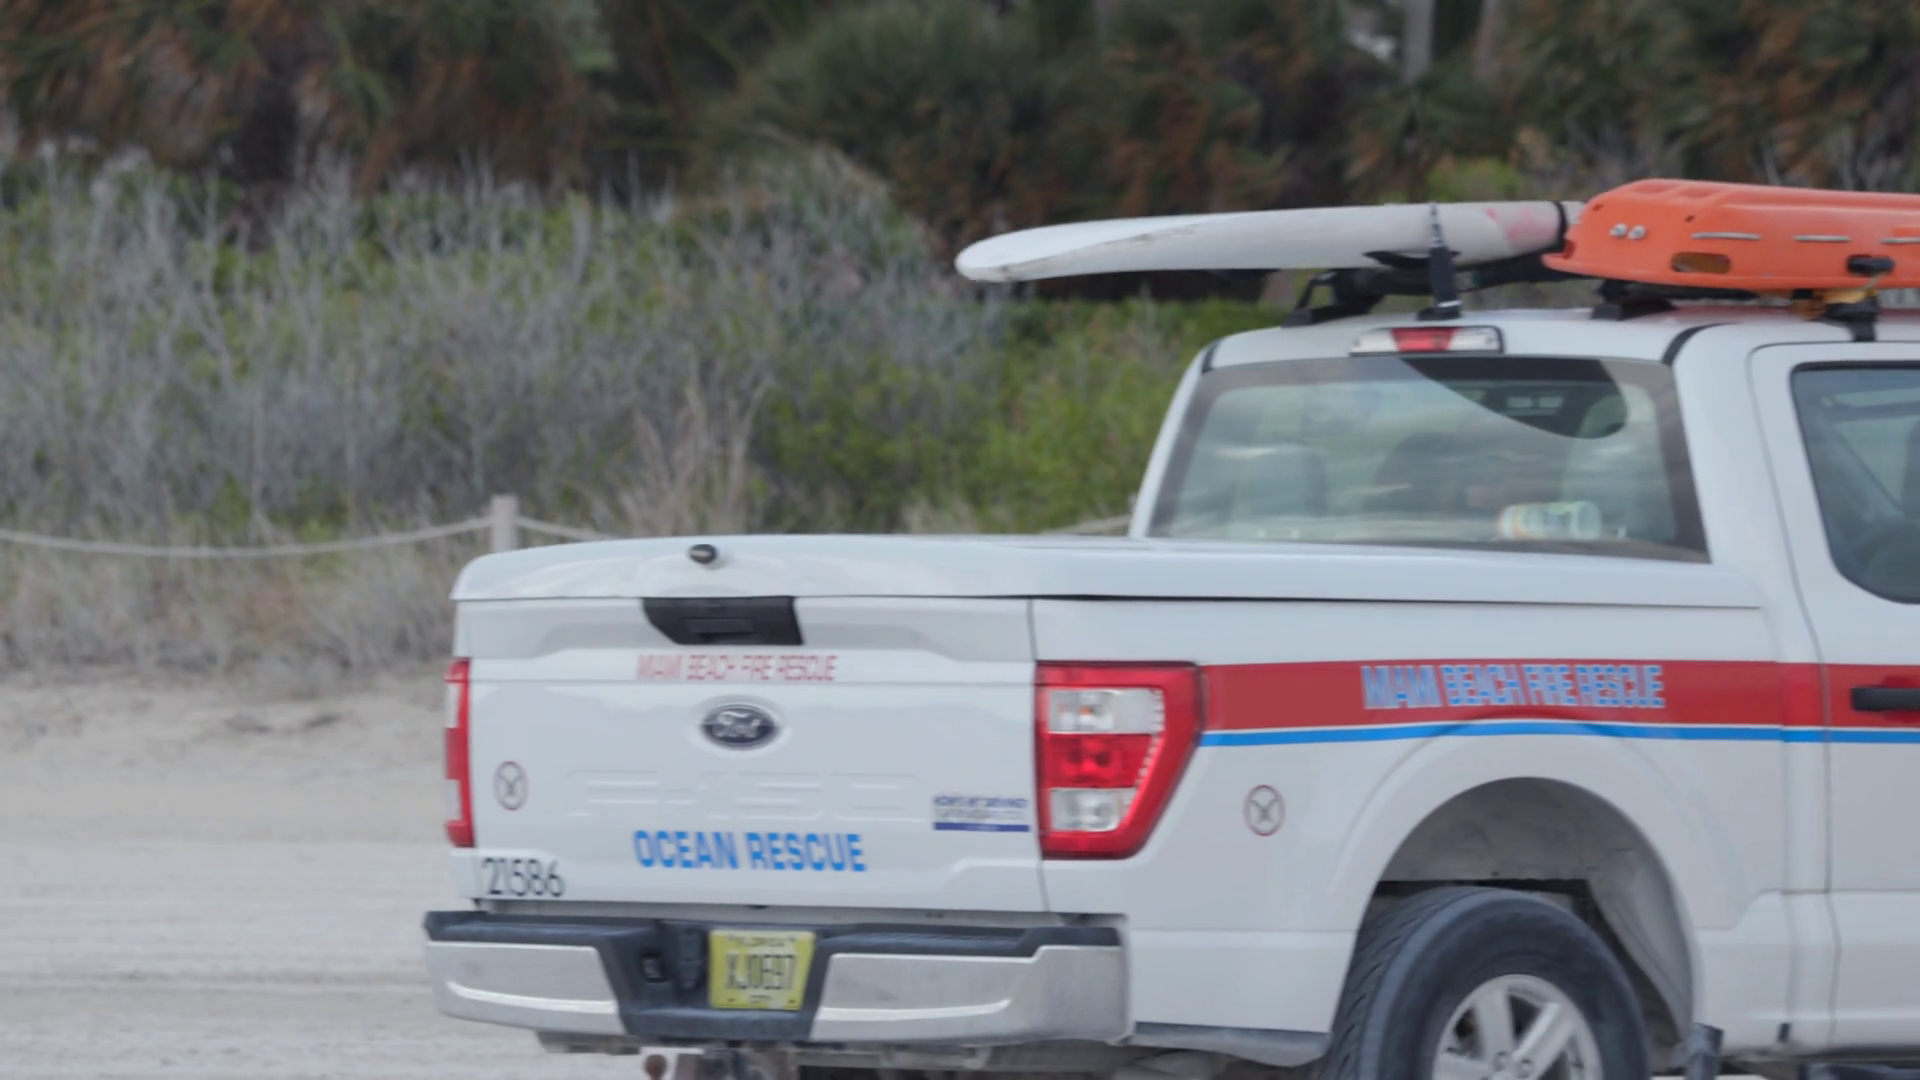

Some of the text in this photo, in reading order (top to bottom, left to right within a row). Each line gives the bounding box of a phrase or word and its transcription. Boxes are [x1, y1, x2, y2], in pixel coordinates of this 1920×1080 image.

[776, 655, 838, 681] RESCUE
[1439, 664, 1527, 706] BEACH
[1520, 664, 1577, 707] FIRE
[1572, 664, 1666, 709] RESCUE
[633, 830, 868, 872] OCEAN RESCUE
[482, 857, 566, 898] 21586
